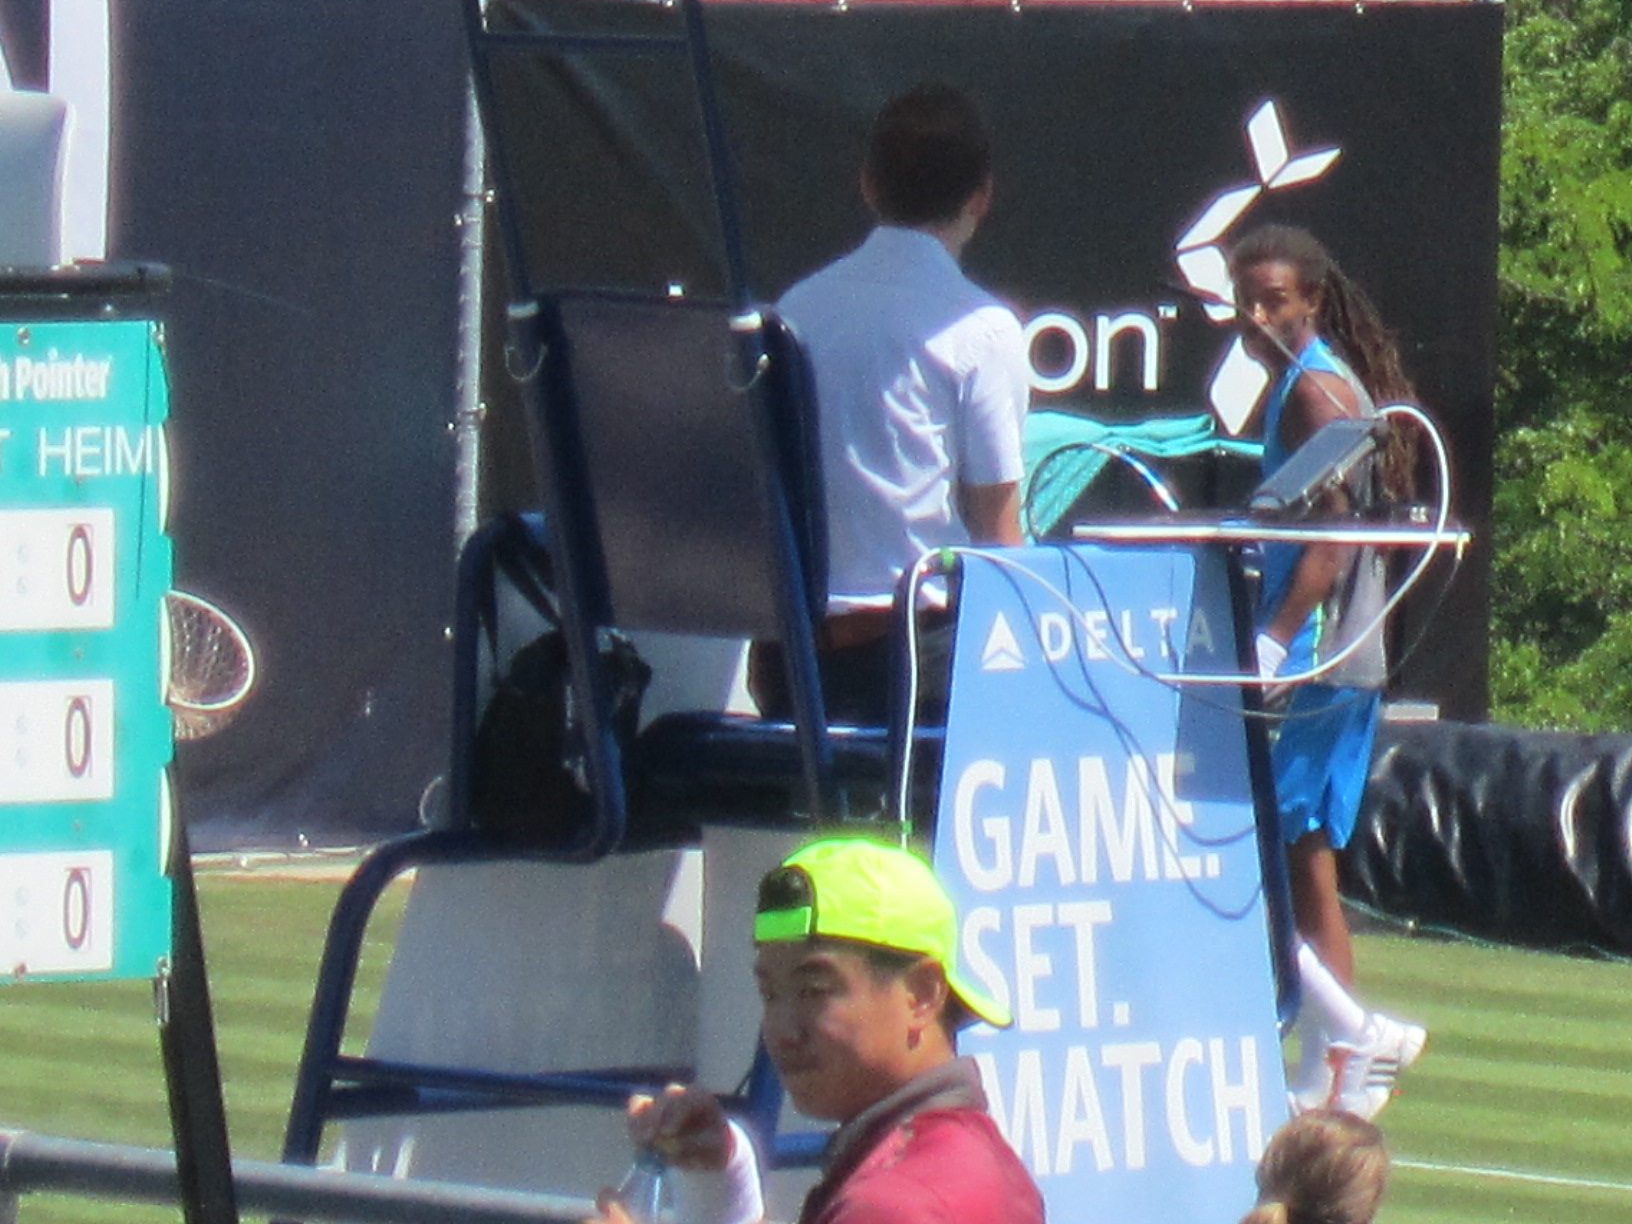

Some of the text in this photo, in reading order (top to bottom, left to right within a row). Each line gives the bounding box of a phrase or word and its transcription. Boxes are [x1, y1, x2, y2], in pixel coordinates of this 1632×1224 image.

[16, 347, 112, 400] Pointer
[39, 426, 153, 476] HEIM
[1039, 608, 1215, 662] DELTA
[961, 900, 1131, 1036] SET.
